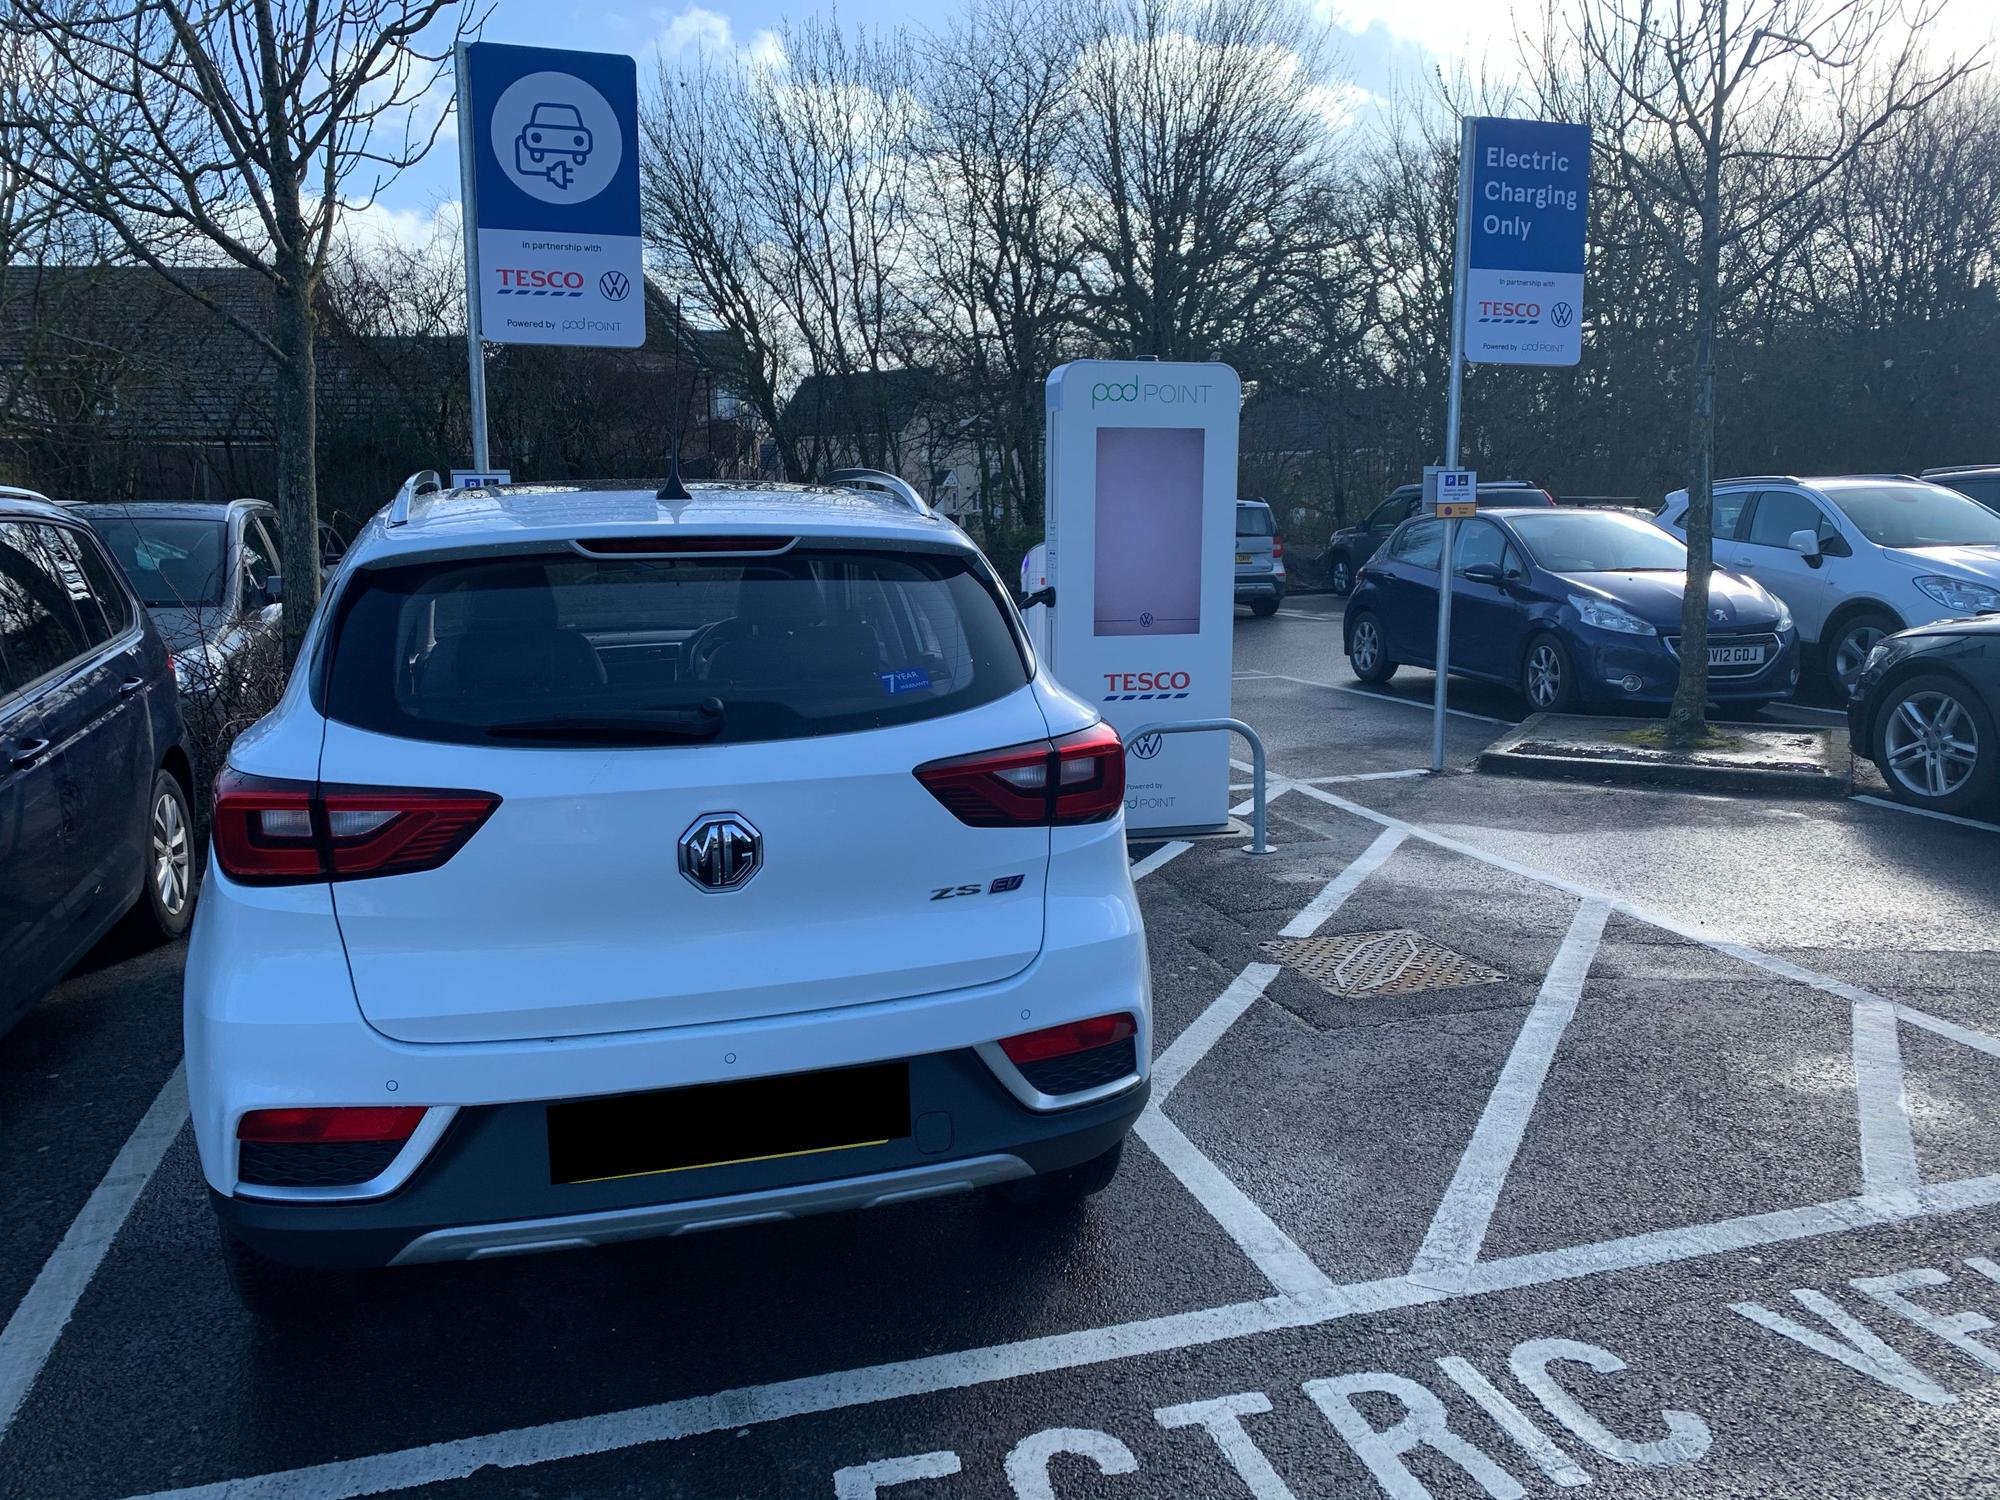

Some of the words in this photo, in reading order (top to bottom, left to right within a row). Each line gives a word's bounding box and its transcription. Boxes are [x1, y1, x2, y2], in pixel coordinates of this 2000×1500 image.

[1486, 147, 1570, 173] Electric
[1484, 181, 1578, 211] Charging
[1483, 215, 1532, 241] Only
[522, 241, 530, 249] In
[532, 242, 582, 252] partnership
[584, 244, 602, 252] with
[495, 269, 585, 289] TESCO
[1506, 279, 1541, 288] partnership
[1479, 301, 1541, 318] TESCO
[507, 319, 543, 329] Powered
[545, 319, 556, 329] by
[562, 317, 586, 332] pod
[587, 321, 623, 332] POINT
[1483, 342, 1509, 350] Powered
[1510, 342, 1518, 351] by
[1540, 343, 1565, 352] POINT
[1092, 374, 1139, 410] pod
[1143, 383, 1213, 404] POINT
[1734, 647, 1757, 661] GDJ
[881, 674, 895, 693] 7
[895, 671, 919, 681] YEAR
[1103, 671, 1190, 692] TESCO
[1126, 782, 1155, 790] Powered
[1124, 795, 1138, 810] od
[1139, 797, 1177, 809] POINT
[686, 821, 755, 886] MG
[929, 884, 982, 901] ZS
[989, 875, 1024, 894] EV
[1727, 1256, 2000, 1407] VE
